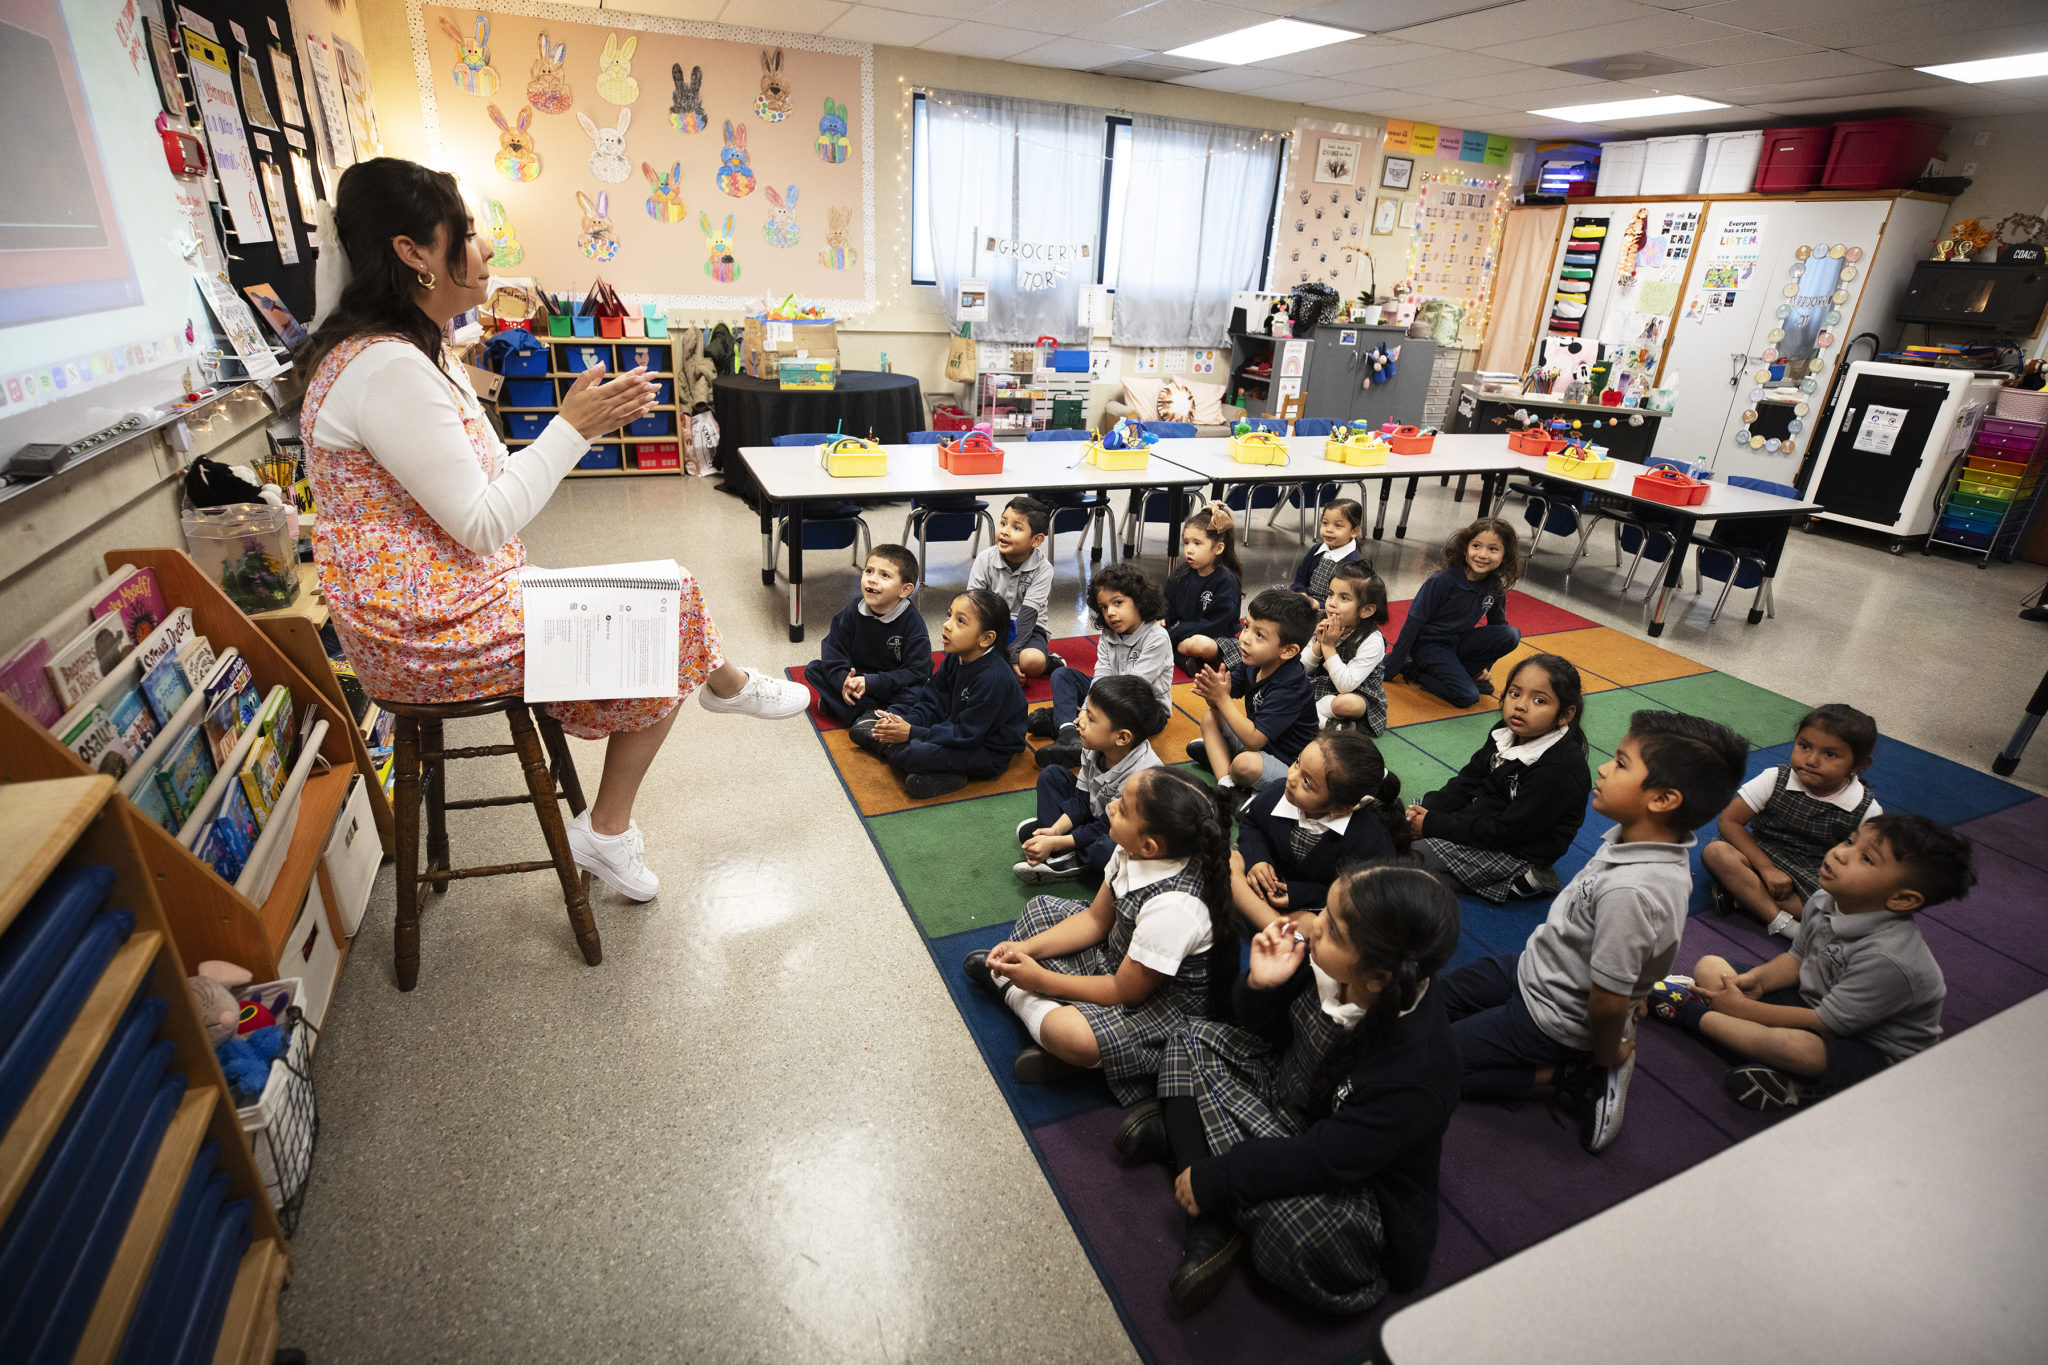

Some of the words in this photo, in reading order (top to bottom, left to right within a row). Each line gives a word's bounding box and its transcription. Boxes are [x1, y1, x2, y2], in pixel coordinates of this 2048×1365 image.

[1719, 236, 1758, 246] LISTEN.
[998, 239, 1078, 261] GROCERY
[2013, 249, 2039, 260] COACH
